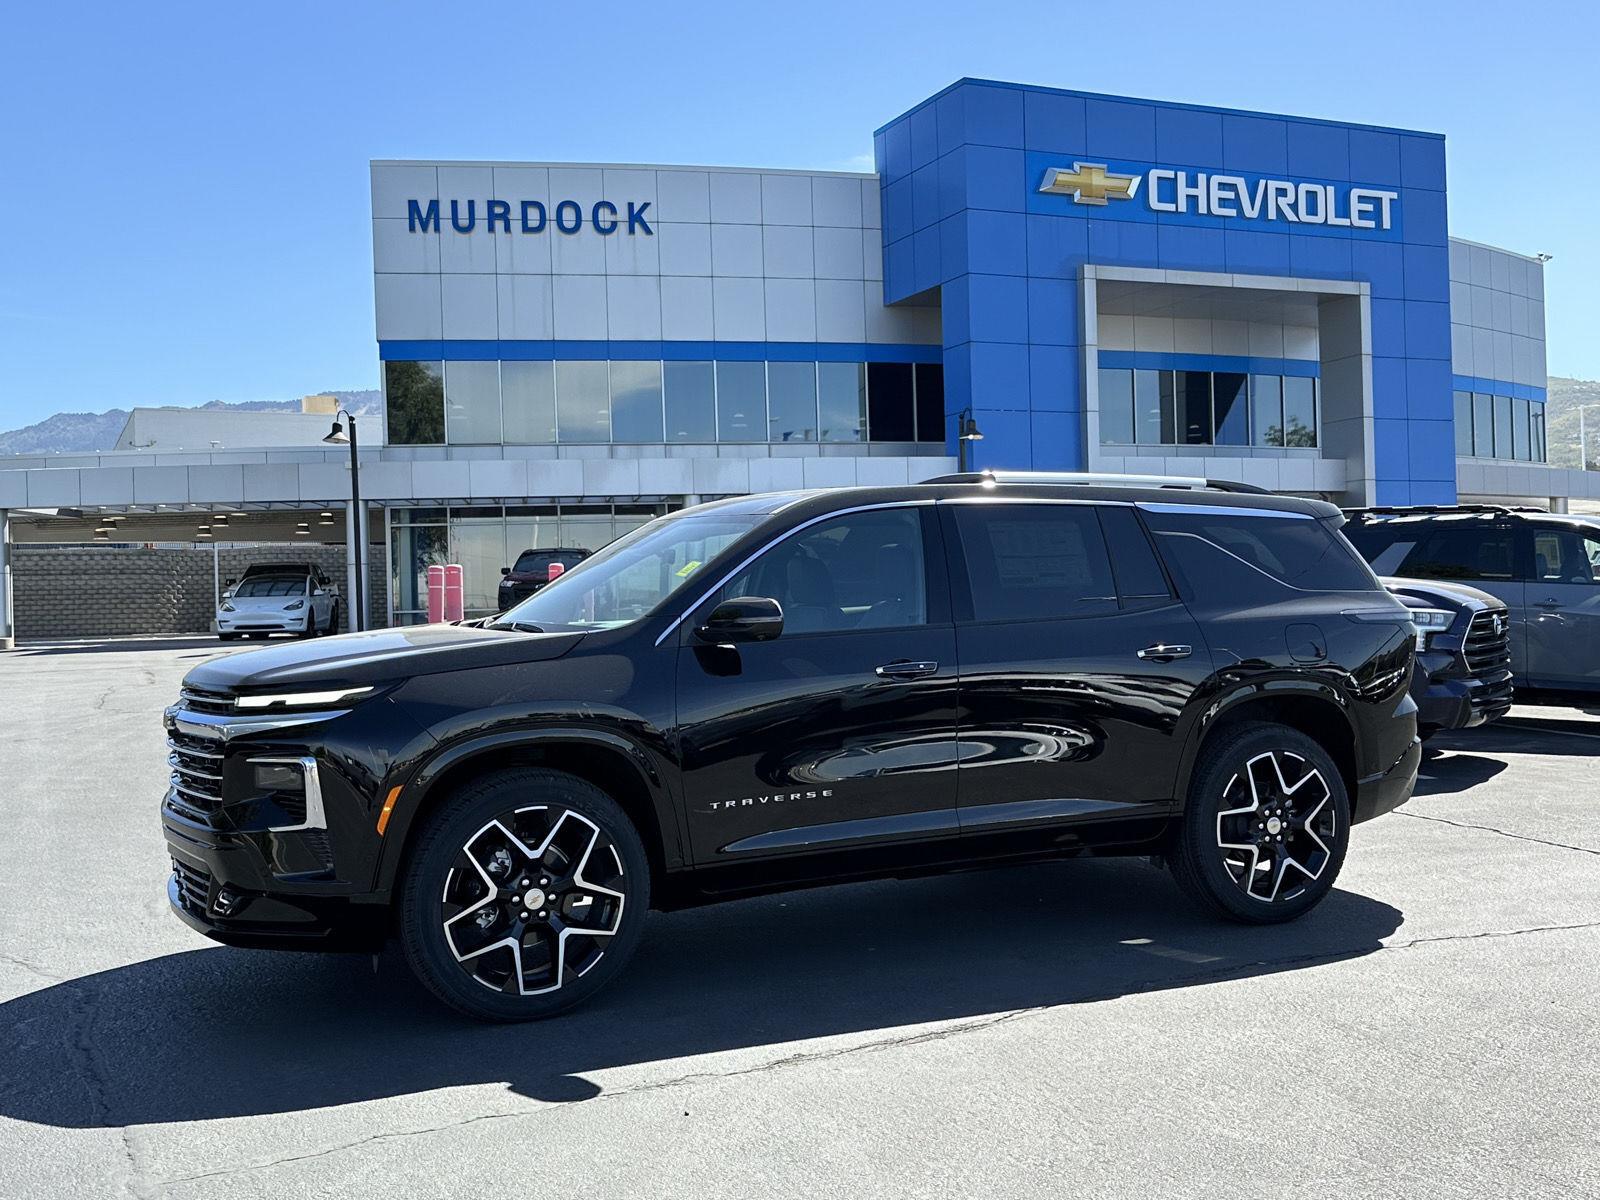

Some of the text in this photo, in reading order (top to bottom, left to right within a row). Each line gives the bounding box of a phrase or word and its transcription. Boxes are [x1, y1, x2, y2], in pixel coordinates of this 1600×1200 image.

[407, 199, 653, 235] MURDOCK
[1148, 169, 1398, 229] CHEVROLET
[709, 789, 833, 809] TRAVERSE
